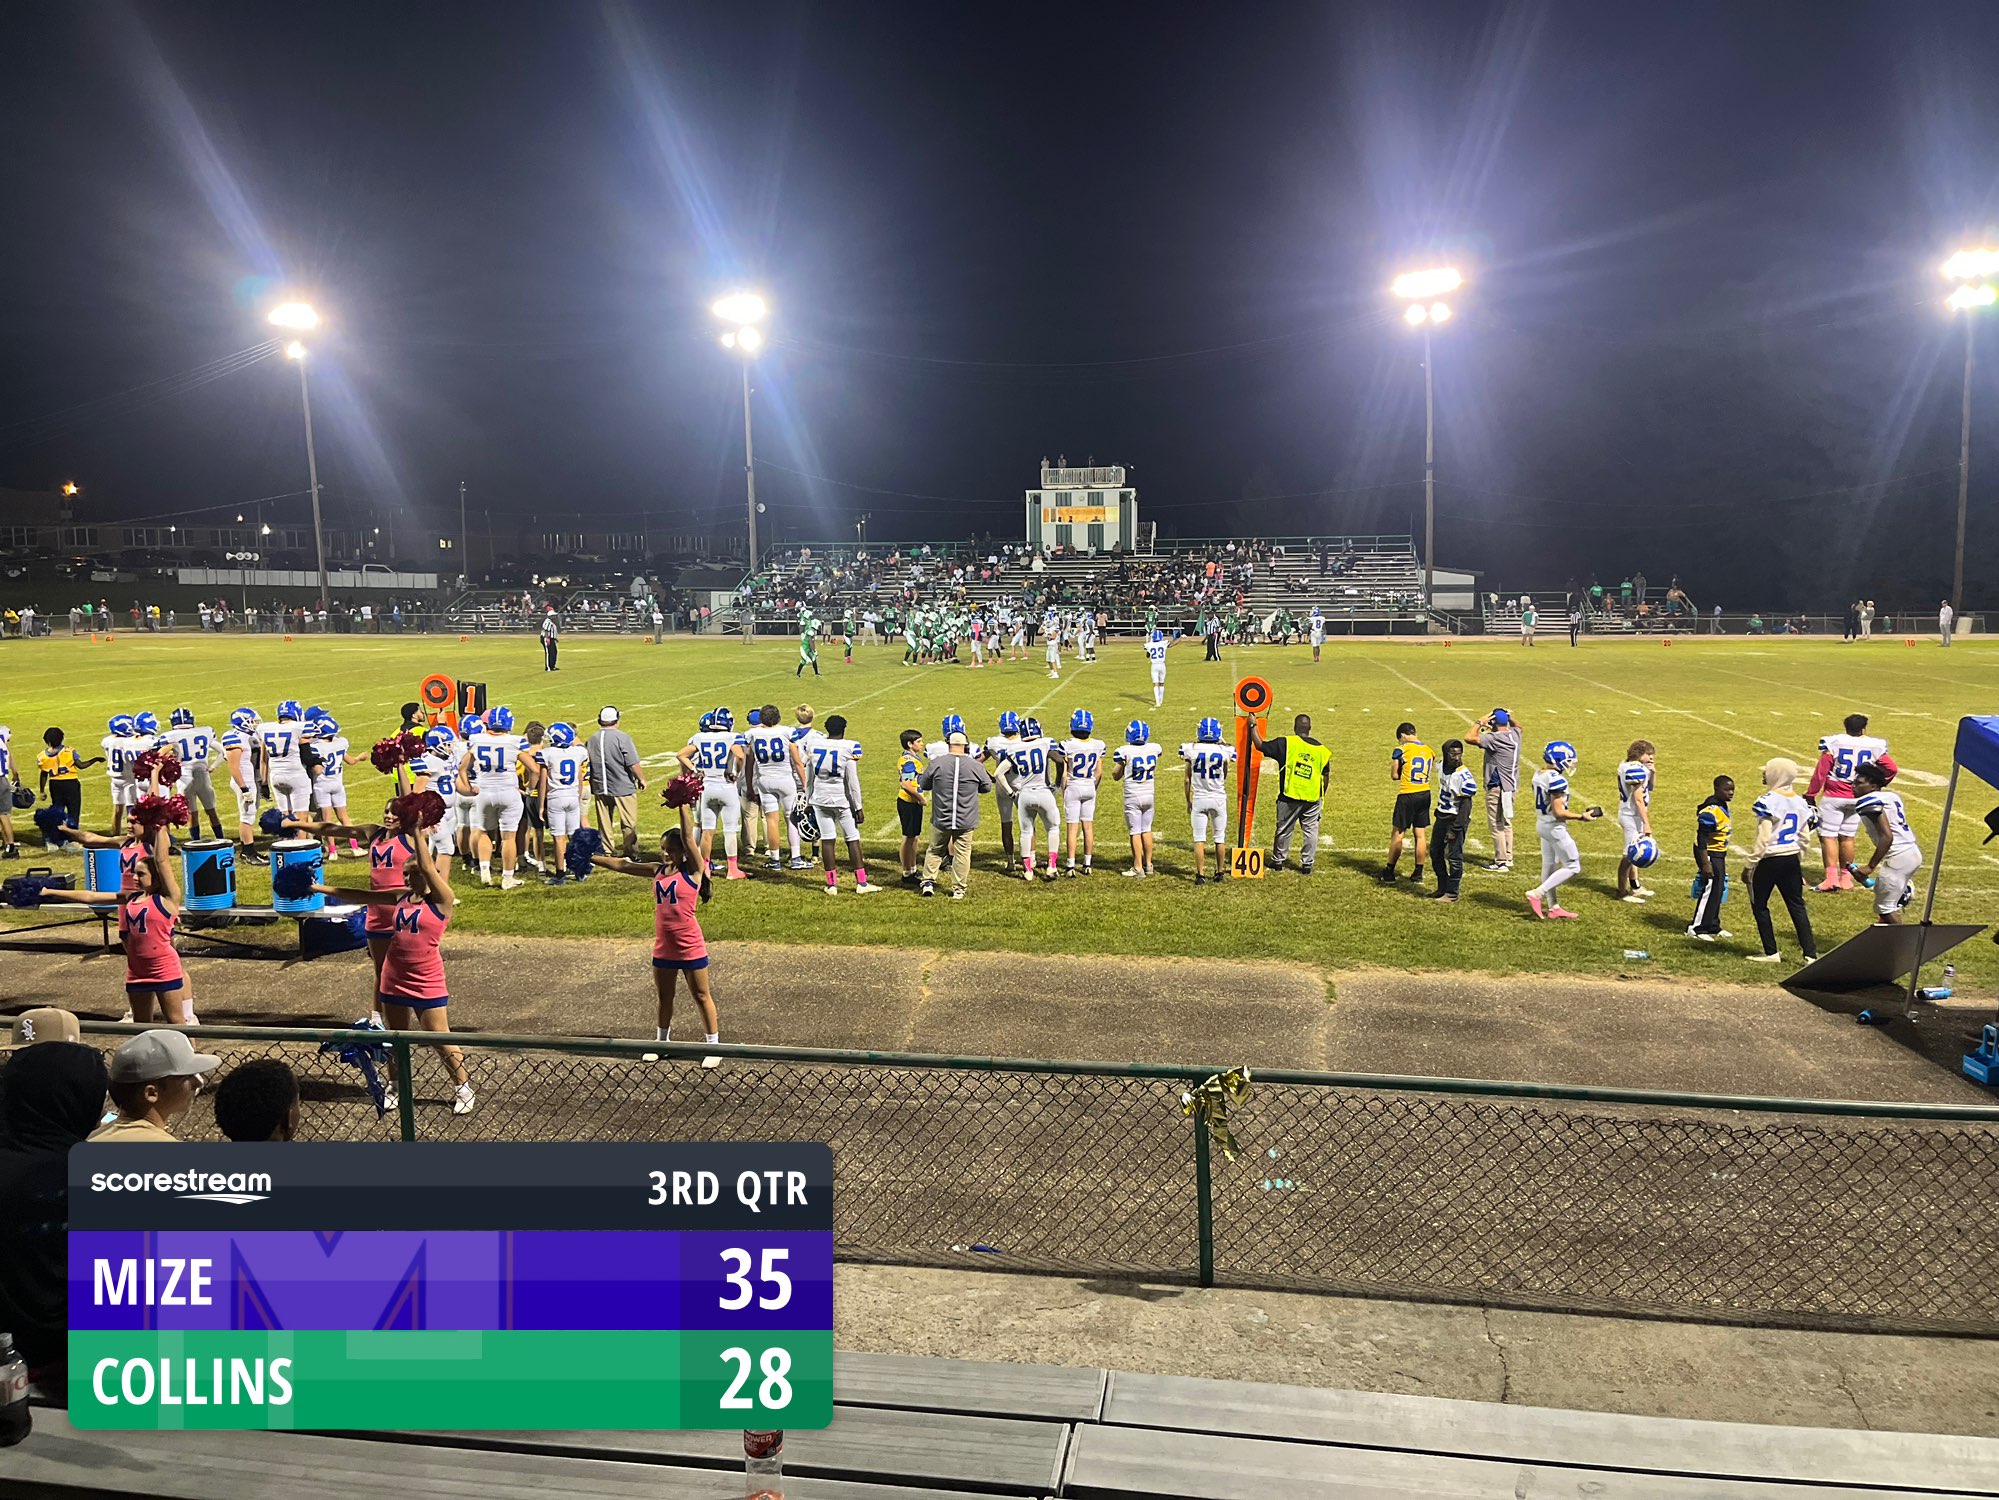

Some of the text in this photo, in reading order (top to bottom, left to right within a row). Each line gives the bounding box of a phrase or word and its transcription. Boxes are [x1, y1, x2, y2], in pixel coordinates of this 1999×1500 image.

[1315, 619, 1322, 629] 8
[1150, 646, 1165, 660] 23
[465, 686, 477, 714] 1
[179, 735, 208, 762] 13
[264, 732, 292, 758] 57
[701, 742, 728, 769] 52
[754, 737, 784, 764] 68
[324, 749, 346, 776] 27
[477, 746, 508, 773] 51
[560, 759, 575, 785] 9
[813, 748, 841, 777] 71
[1015, 748, 1044, 777] 50
[1073, 753, 1097, 778] 22
[1132, 755, 1157, 781] 62
[1194, 752, 1223, 780] 42
[1410, 757, 1431, 784] 21
[1460, 771, 1473, 782] 15
[1777, 813, 1798, 845] 2
[120, 852, 138, 873] M
[371, 846, 394, 869] M
[1235, 850, 1261, 876] 40
[656, 880, 678, 905] M
[126, 908, 148, 934] M
[396, 907, 421, 934] M
